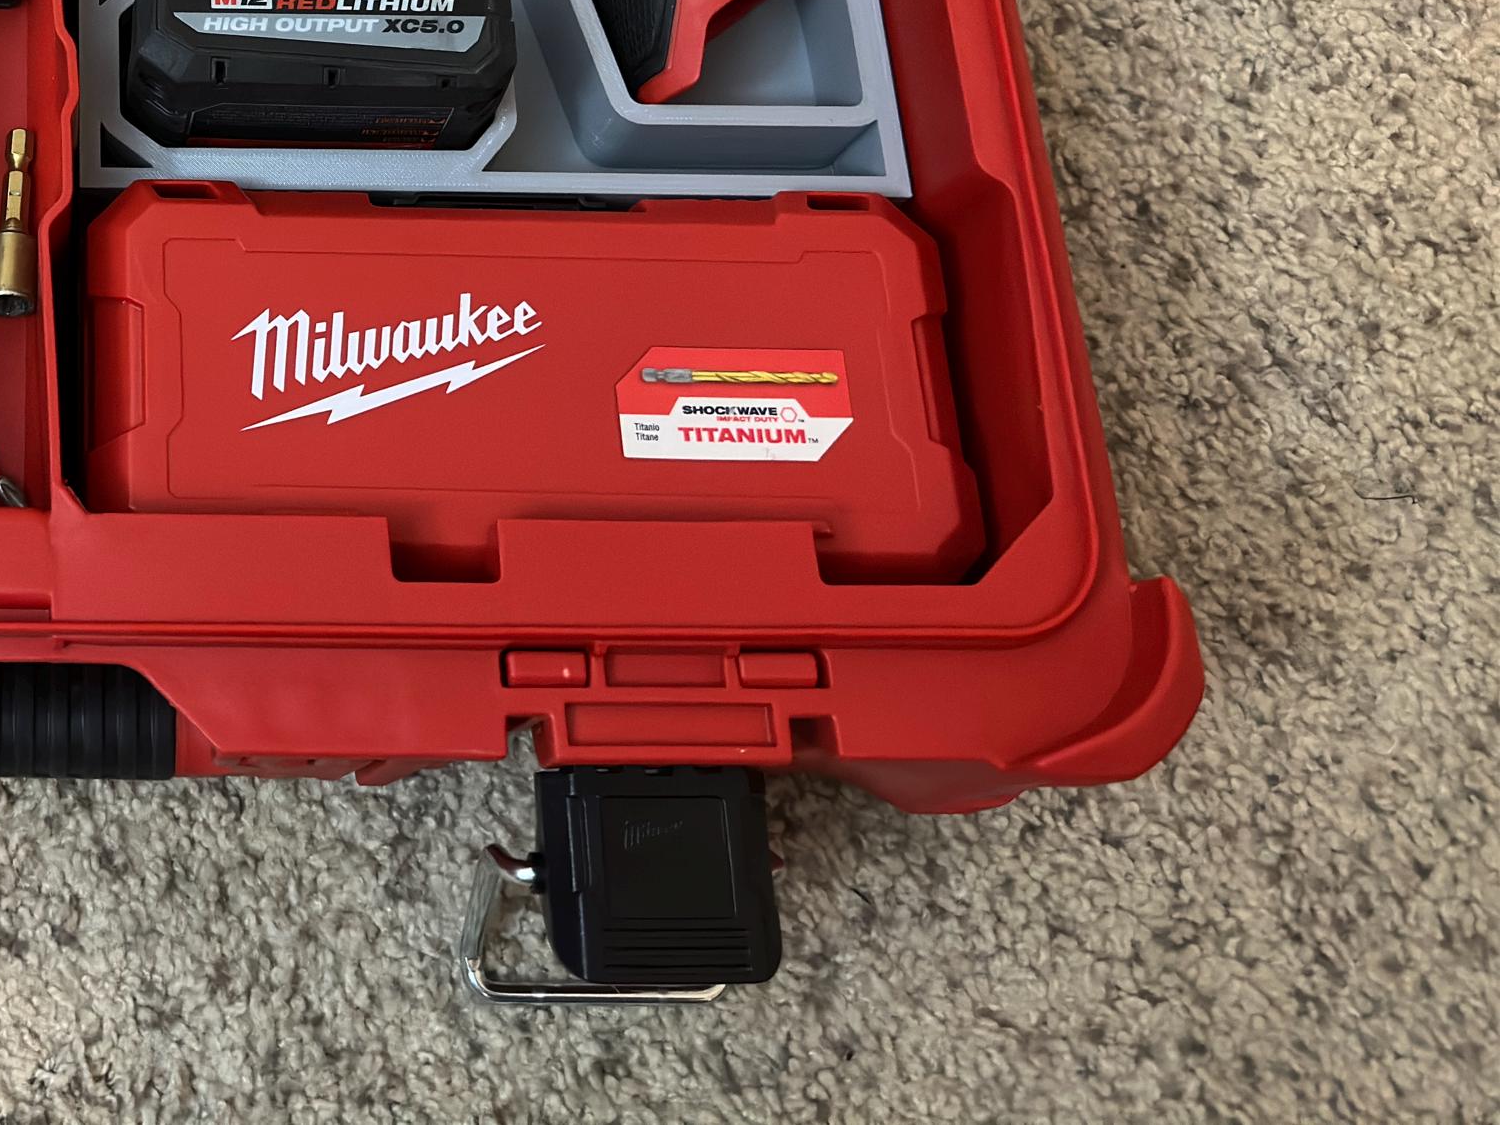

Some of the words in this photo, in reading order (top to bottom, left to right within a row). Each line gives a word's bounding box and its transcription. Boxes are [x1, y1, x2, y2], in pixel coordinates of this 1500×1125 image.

[203, 17, 269, 32] HIGH
[276, 18, 380, 33] OUTPUT
[382, 19, 465, 35] XC5.0
[231, 293, 544, 400] Milwaukee
[682, 405, 778, 416] SHOCKWAVE
[634, 422, 660, 432] Titanio
[636, 432, 659, 442] Titane
[678, 427, 807, 444] TITANIUM
